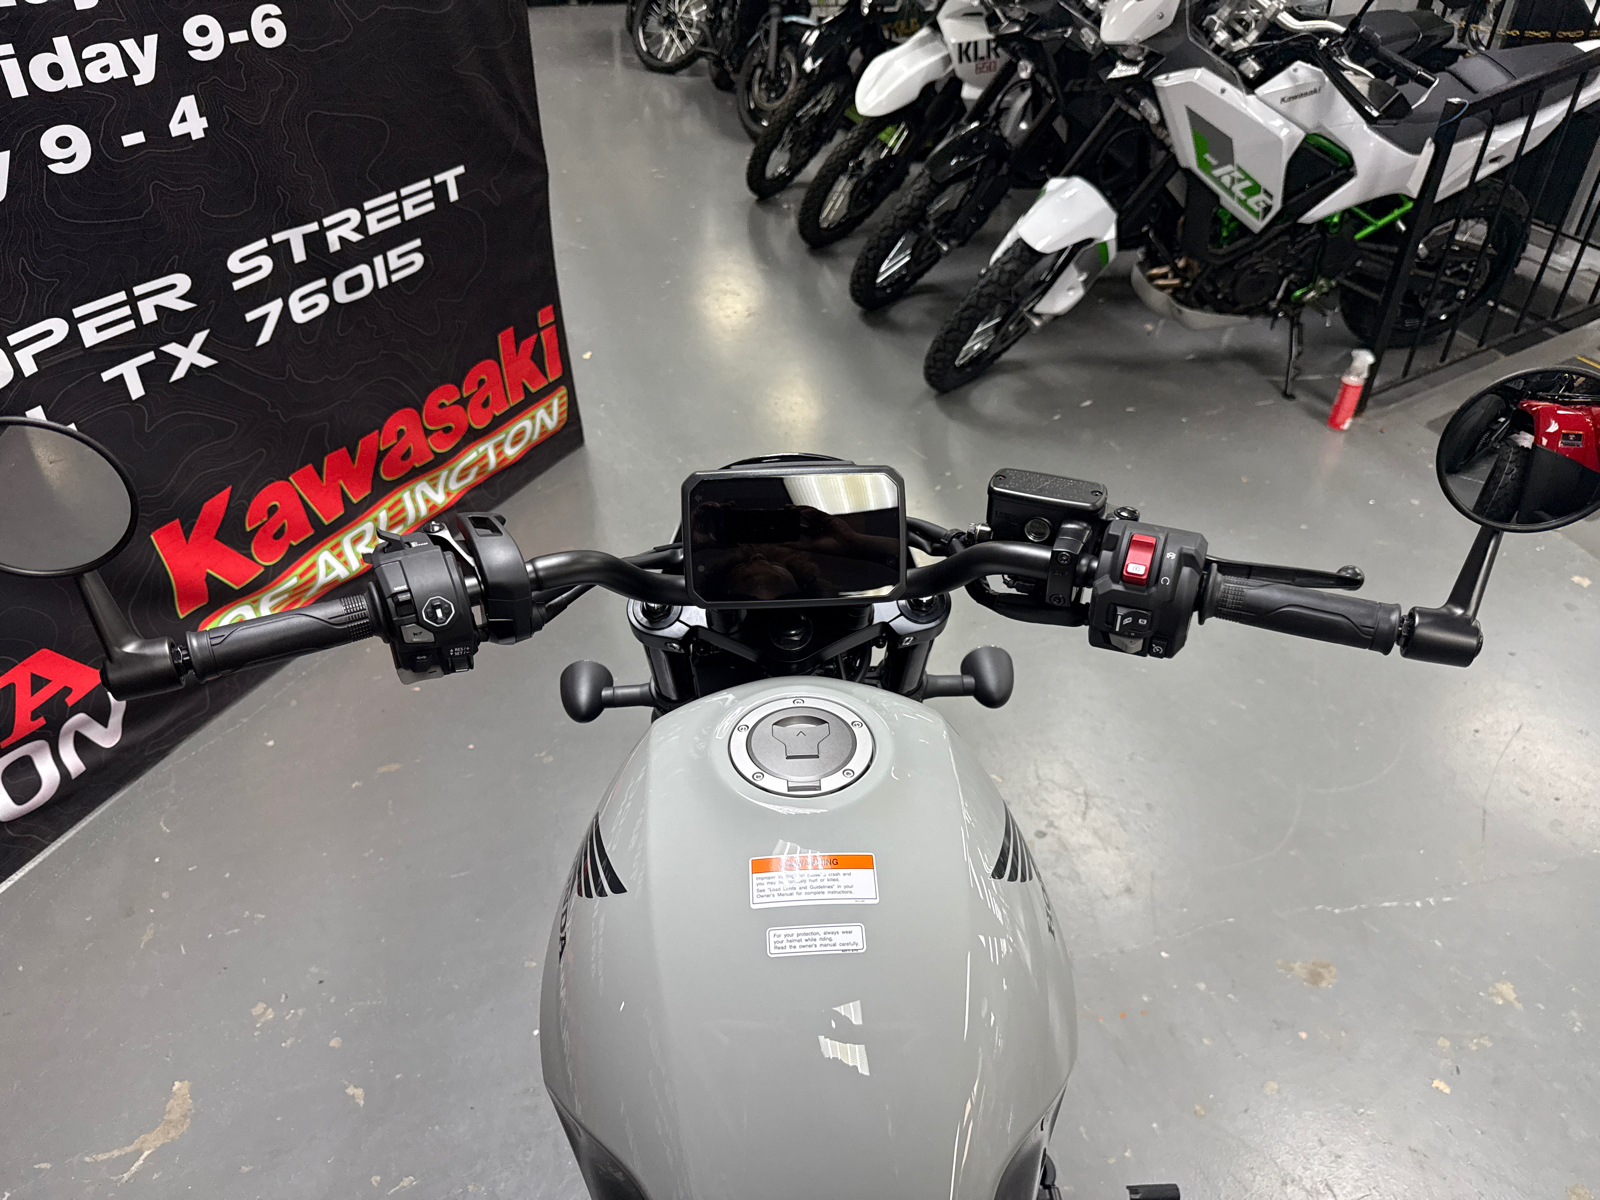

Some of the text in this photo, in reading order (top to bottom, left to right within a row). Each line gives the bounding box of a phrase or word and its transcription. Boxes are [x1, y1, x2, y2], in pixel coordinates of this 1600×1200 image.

[183, 3, 287, 61] 9-6
[957, 38, 1000, 64] KLR
[39, 124, 92, 175] 9
[168, 94, 209, 141] 4
[226, 165, 466, 291] STREET
[100, 238, 425, 401] TX 76015
[151, 304, 564, 620] Kawasaki
[306, 397, 560, 598] ARLINGTON
